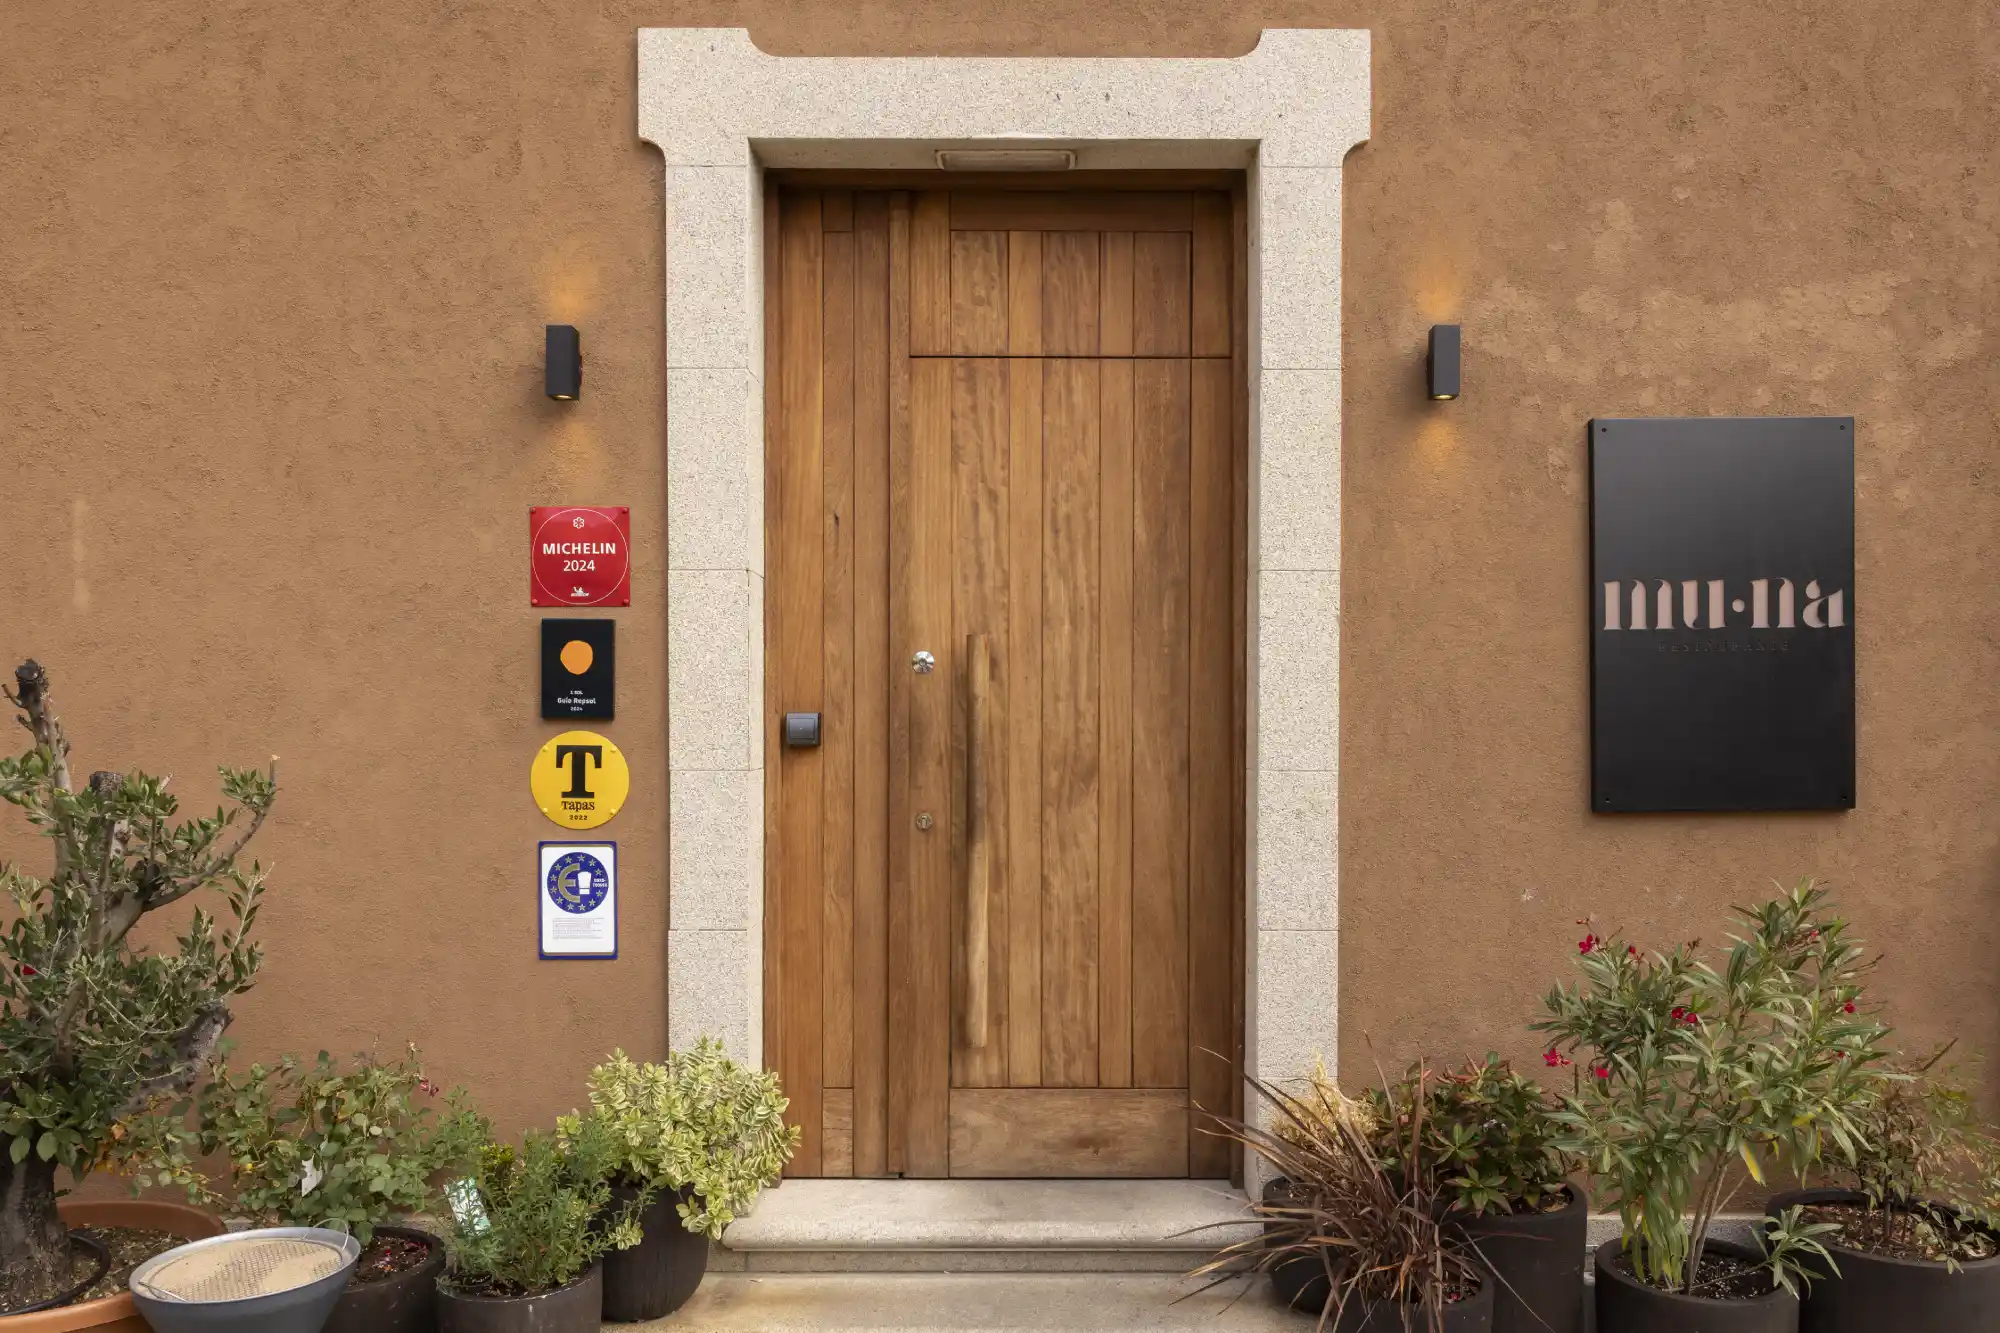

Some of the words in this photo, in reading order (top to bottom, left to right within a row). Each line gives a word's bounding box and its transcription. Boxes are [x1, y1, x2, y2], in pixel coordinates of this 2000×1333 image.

[543, 543, 616, 554] MICHELIN
[563, 560, 595, 571] 2024
[573, 697, 596, 705] Repsol
[556, 745, 602, 798] T
[561, 801, 595, 812] Tapas
